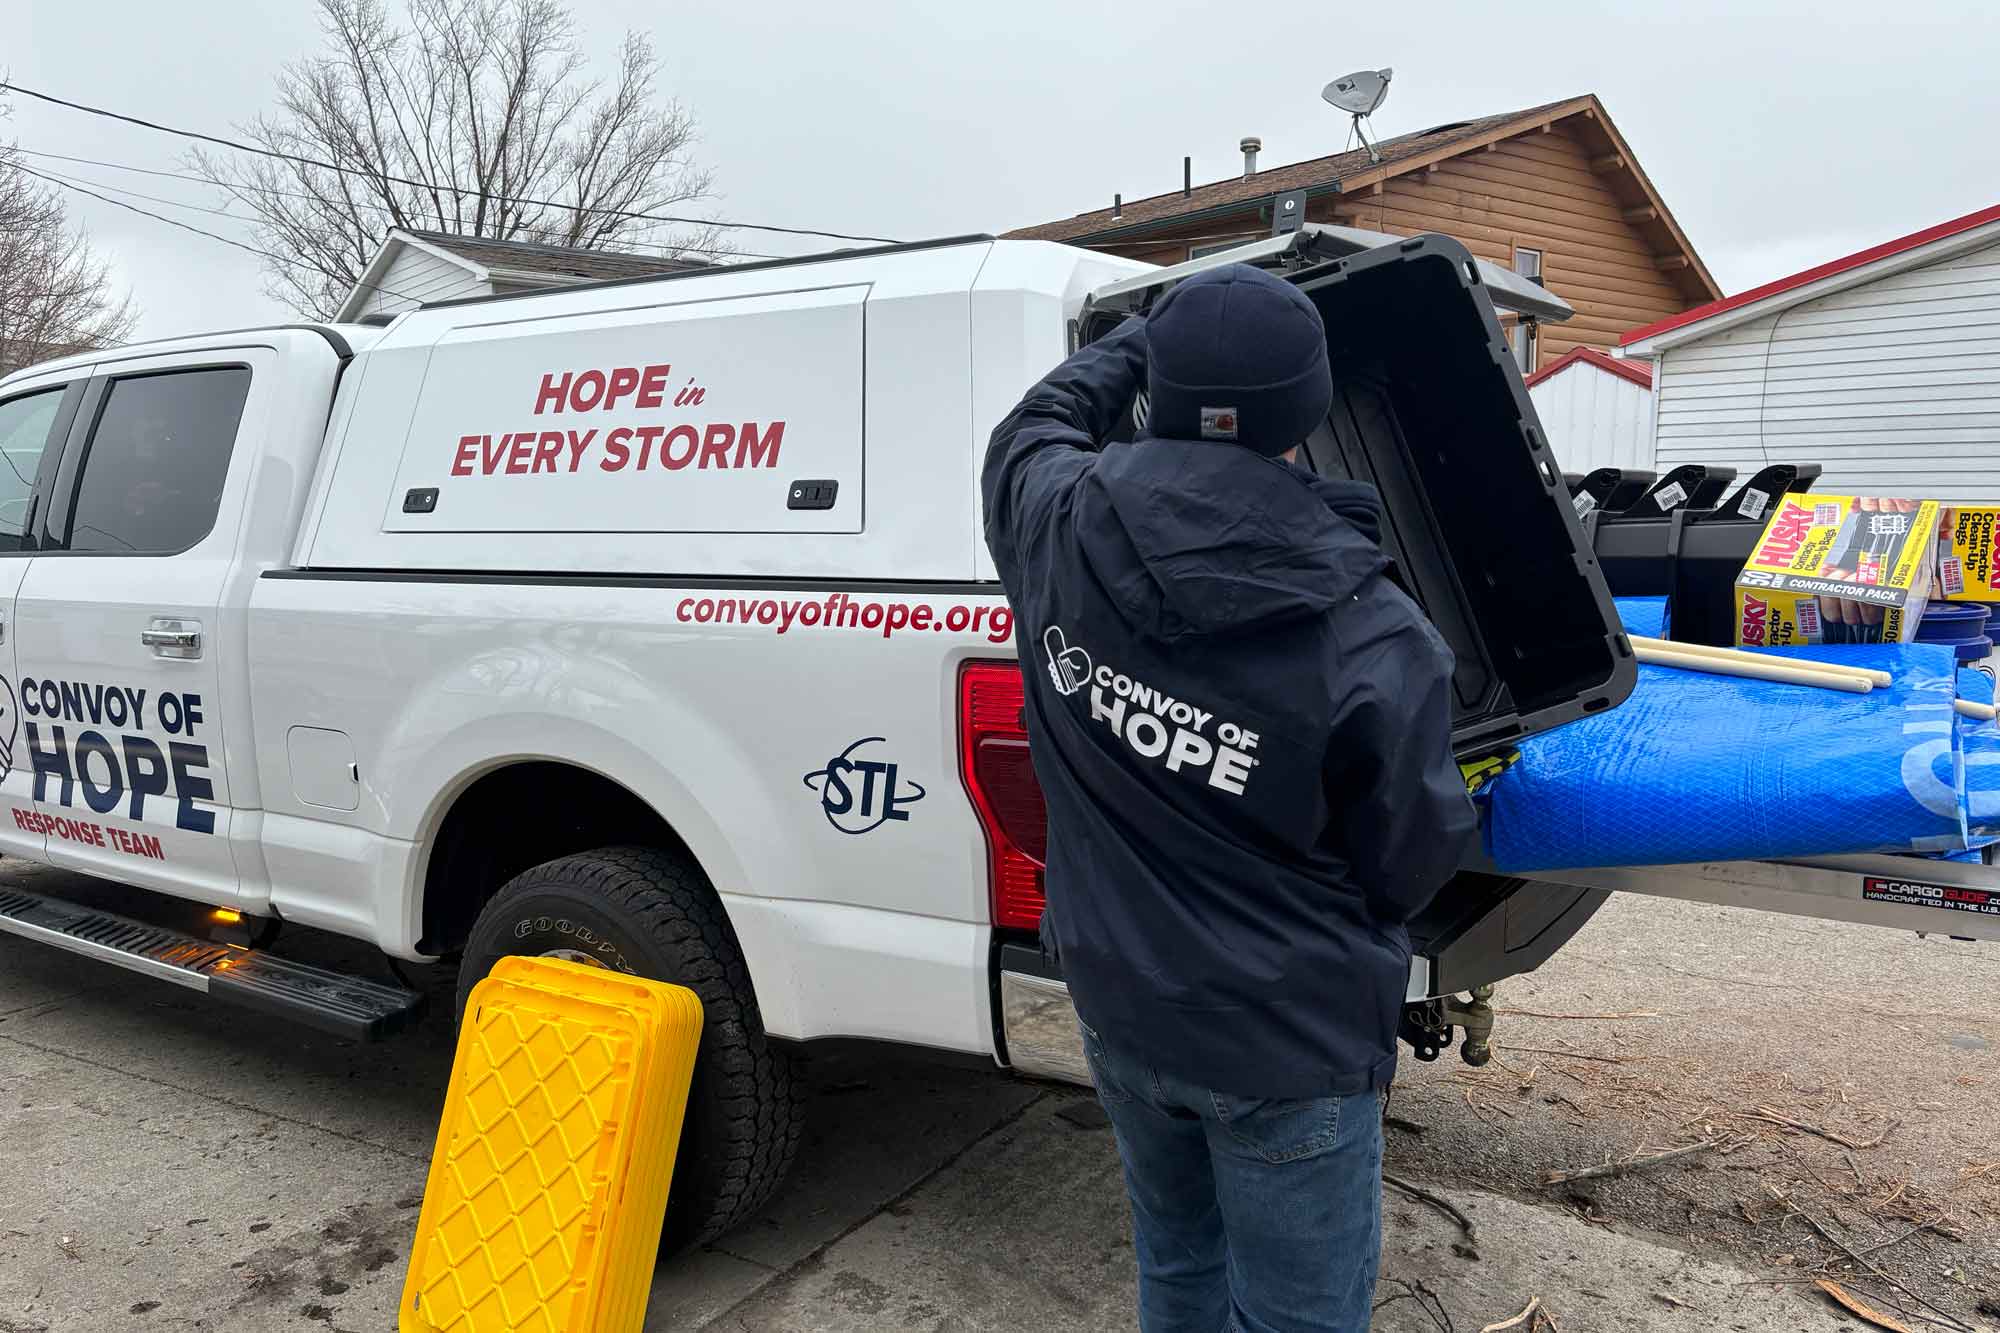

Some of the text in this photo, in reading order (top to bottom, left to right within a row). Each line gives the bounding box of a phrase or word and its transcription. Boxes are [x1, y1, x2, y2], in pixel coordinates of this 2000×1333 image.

[534, 364, 706, 415] HOPE in
[451, 421, 786, 477] EVERY STORM
[1754, 501, 1815, 568] HUSKY
[1955, 512, 1971, 546] Bags
[1977, 512, 1994, 583] Contractor
[1740, 571, 1776, 586] 50
[1789, 578, 1898, 601] CONTRACTOR PACK
[1891, 575, 1906, 586] 50
[676, 593, 1015, 643] convoyofhope.org
[1888, 609, 1900, 631] BAGS
[20, 677, 203, 736] CONVOY OF
[1095, 664, 1260, 751] CONVOY OF
[1090, 684, 1255, 796] HOPE
[25, 721, 216, 835] HOPE
[821, 757, 909, 821] STL
[12, 807, 165, 860] RESPONSE TEAM
[1866, 892, 1942, 907] HANDCRAFTED
[1944, 901, 1955, 909] IN
[1957, 902, 1979, 912] THE
